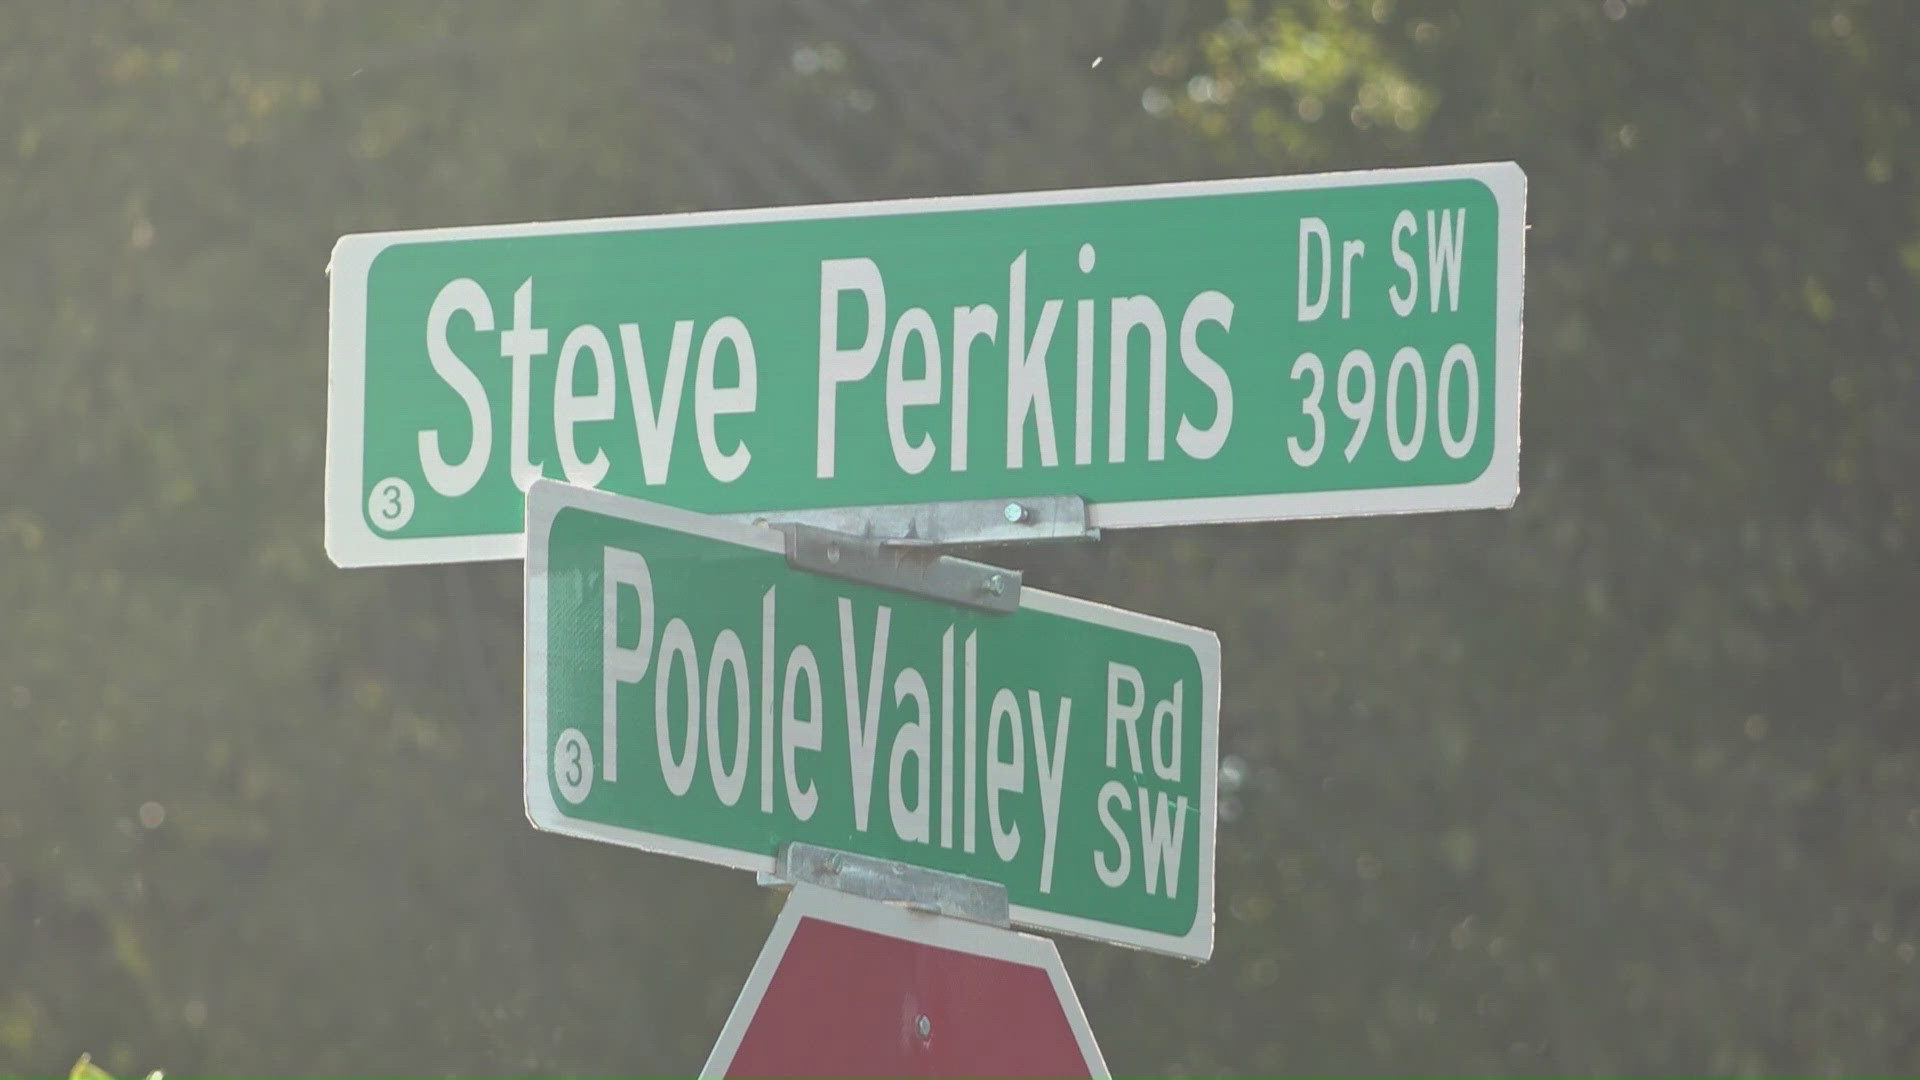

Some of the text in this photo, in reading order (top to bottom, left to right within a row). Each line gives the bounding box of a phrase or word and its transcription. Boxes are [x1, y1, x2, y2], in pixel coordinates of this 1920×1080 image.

[1297, 207, 1467, 323] Dr SW
[417, 242, 1236, 499] Steve Perkins
[1286, 342, 1480, 468] 3900
[382, 485, 402, 519] 3
[565, 739, 583, 788] 3
[602, 545, 1073, 895] Poole Valley
[1105, 660, 1184, 784] Rd
[1092, 779, 1189, 900] SW
